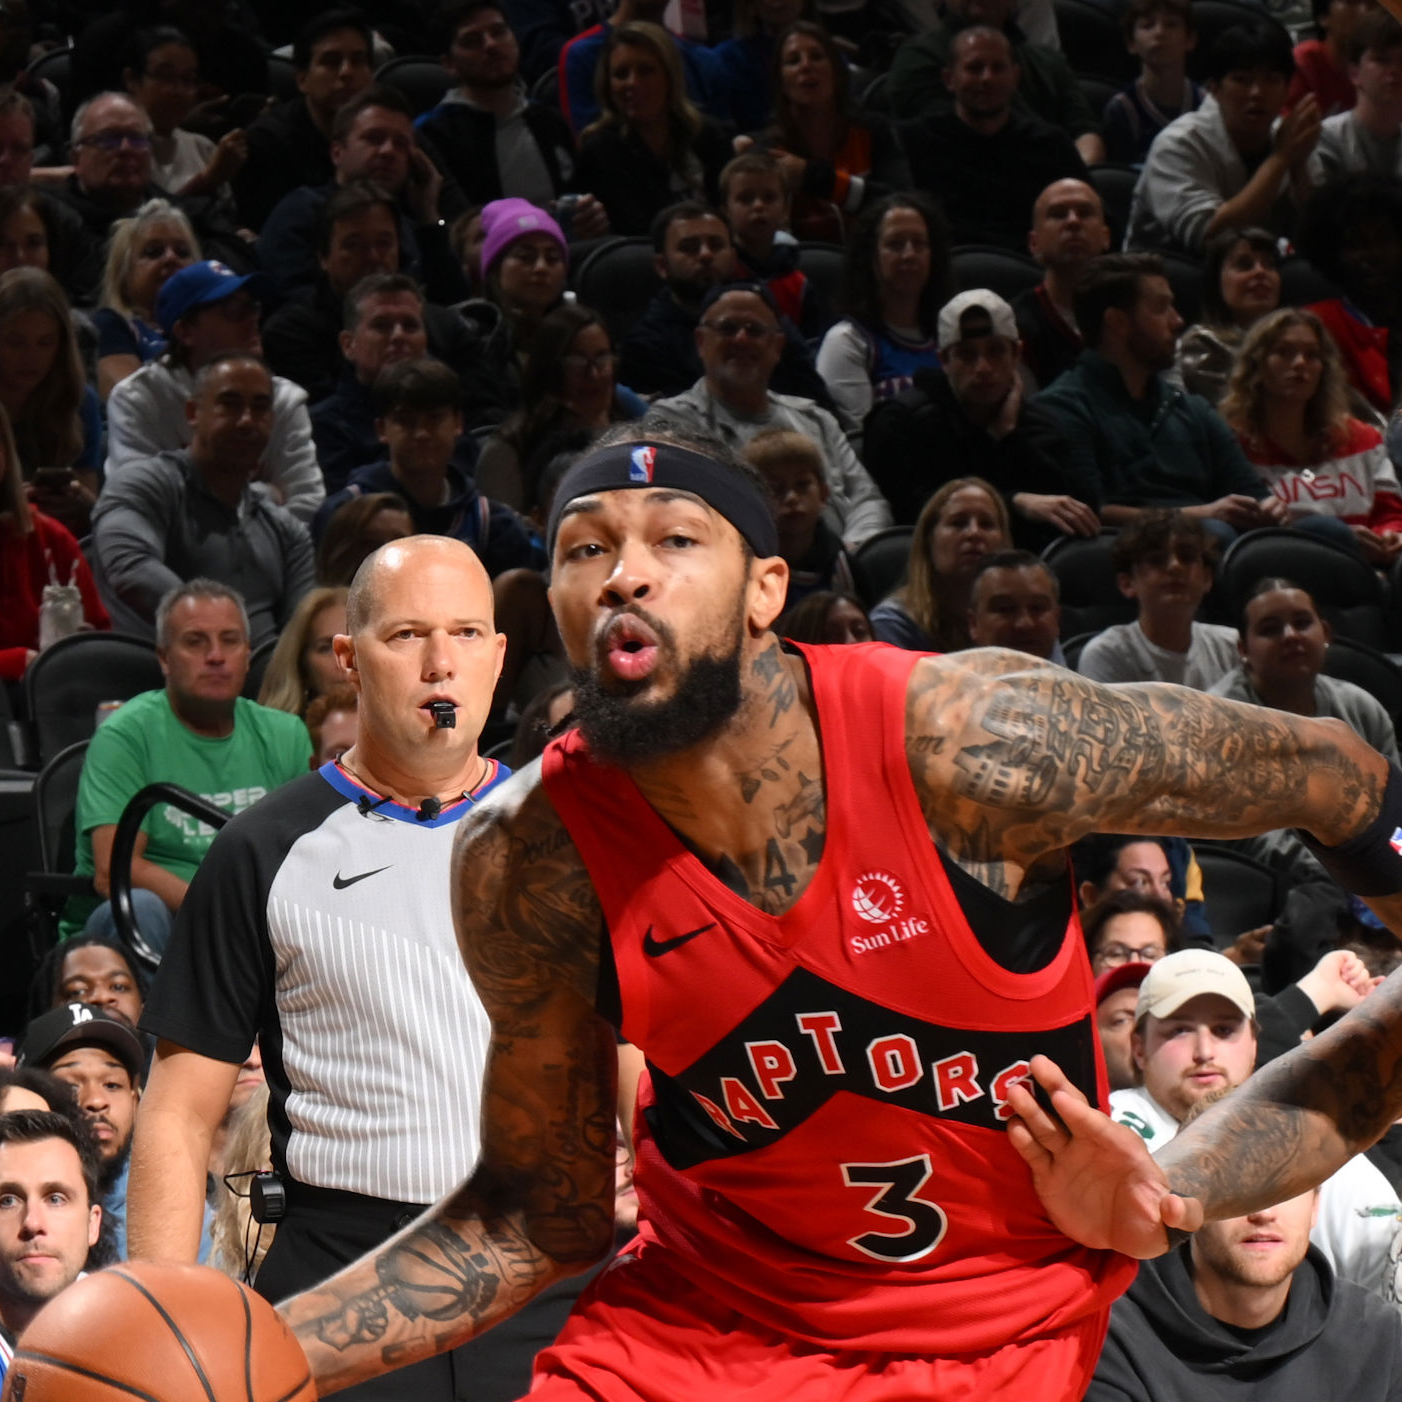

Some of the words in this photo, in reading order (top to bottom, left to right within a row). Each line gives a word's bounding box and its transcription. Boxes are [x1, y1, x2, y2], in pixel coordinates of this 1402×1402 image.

[1261, 472, 1365, 503] NASA
[850, 932, 891, 954] Sun
[889, 916, 930, 942] Life
[689, 1010, 1035, 1143] RAPTORS
[839, 1153, 949, 1264] 3
